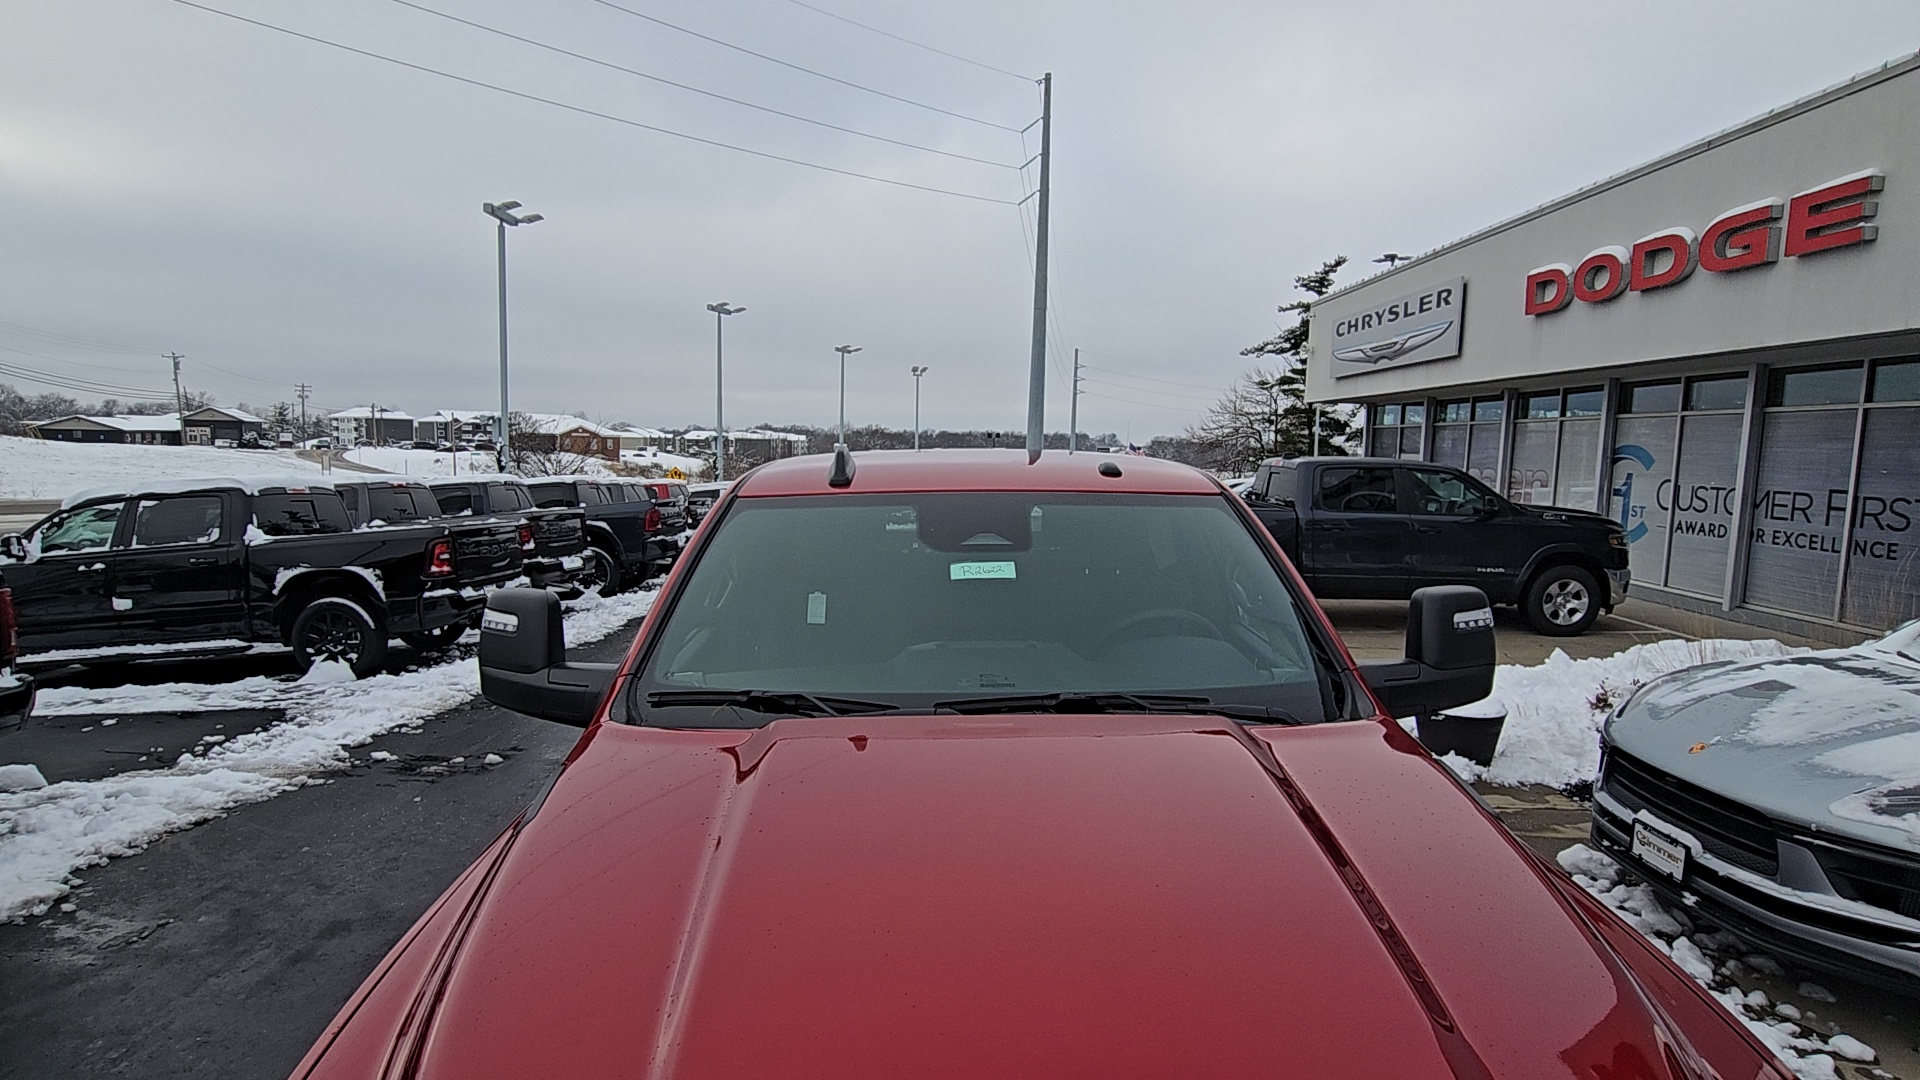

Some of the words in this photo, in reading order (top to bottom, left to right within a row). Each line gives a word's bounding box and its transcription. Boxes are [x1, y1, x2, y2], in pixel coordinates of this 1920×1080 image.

[1525, 172, 1884, 316] DODGE
[1335, 288, 1453, 338] CHRYSLER
[1825, 488, 1920, 532] FIRS
[1674, 520, 1728, 539] AWARD
[1772, 530, 1899, 561] EXCELLNCE
